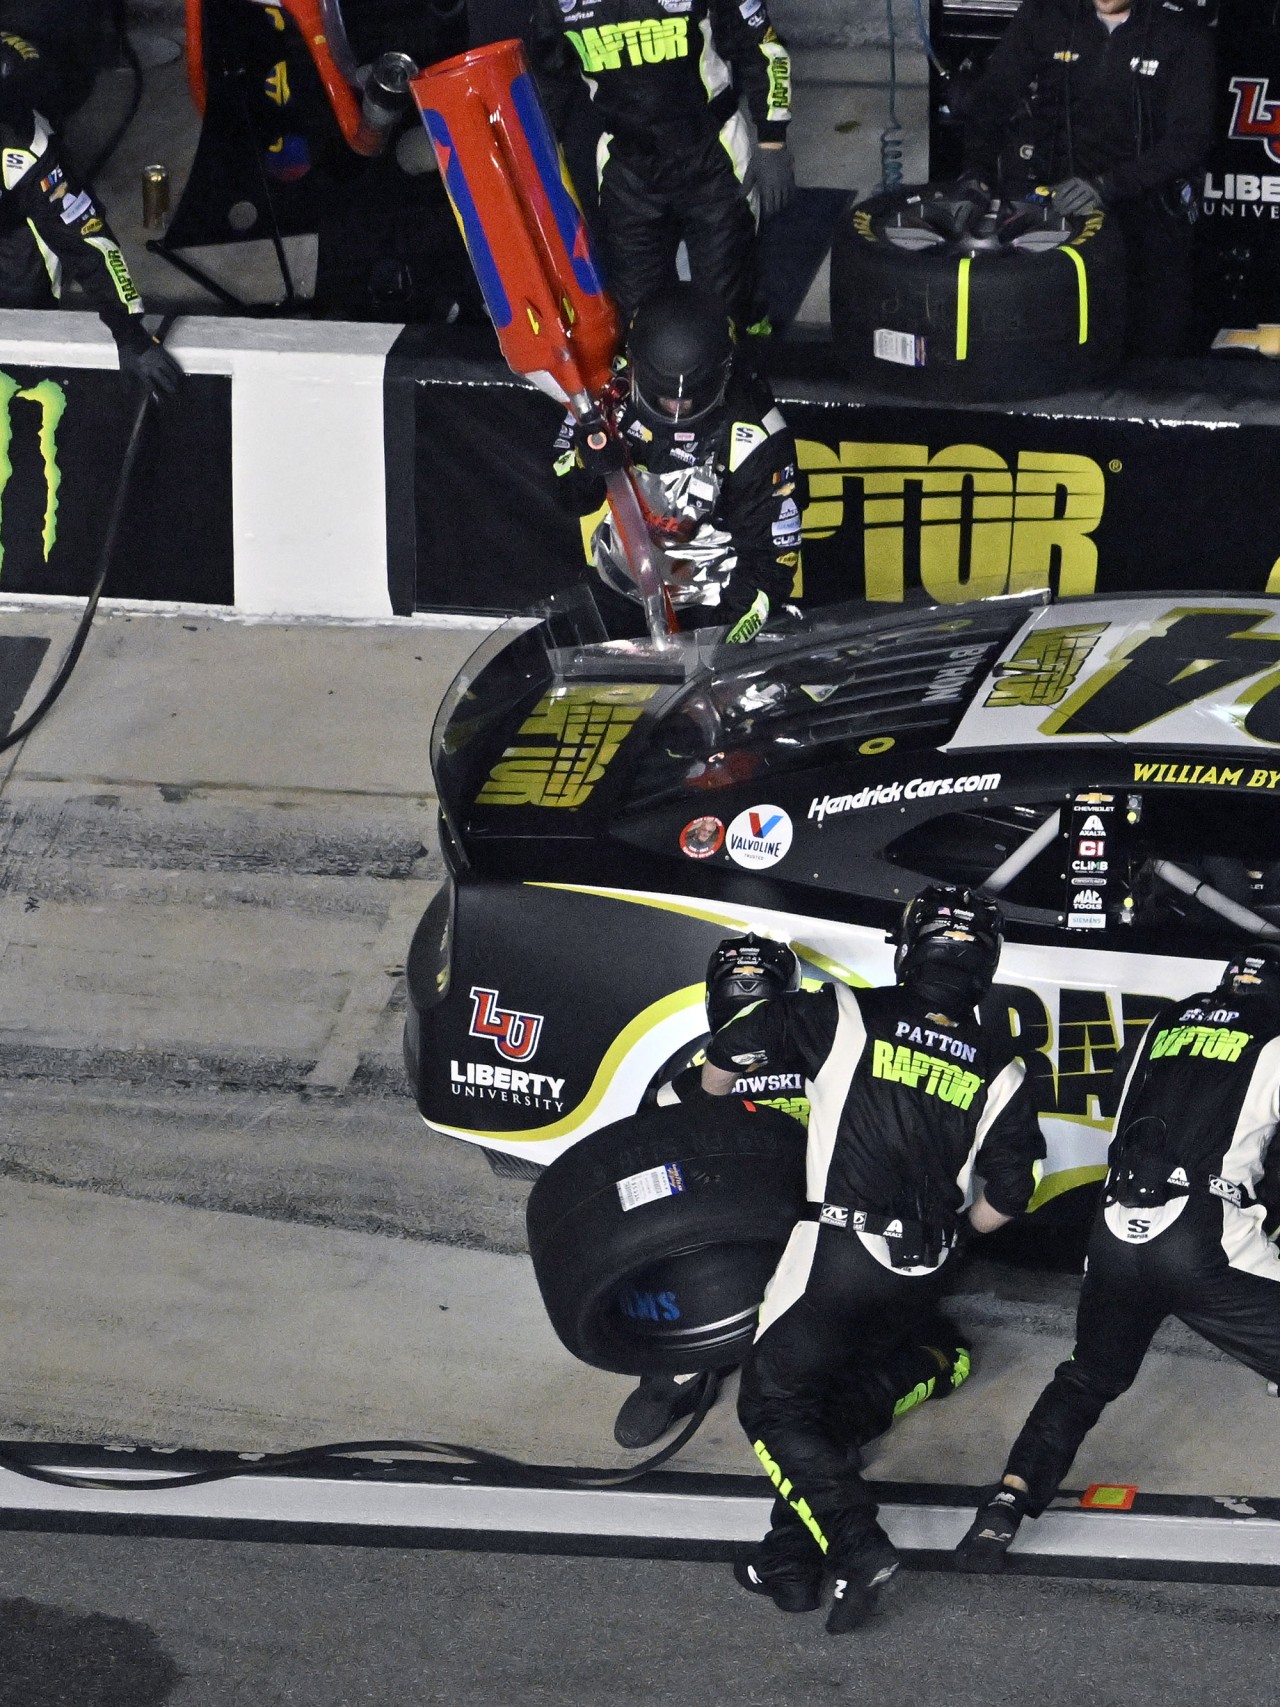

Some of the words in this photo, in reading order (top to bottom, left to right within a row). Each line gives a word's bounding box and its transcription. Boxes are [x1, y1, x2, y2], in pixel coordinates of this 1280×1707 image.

[1134, 763, 1244, 786] WILLIAM
[730, 833, 782, 858] VALVOLINE
[1073, 889, 1103, 904] MAC
[895, 1021, 977, 1063] PATTON
[450, 1060, 565, 1100] LIBERTY
[731, 1073, 801, 1096] OWSKI
[872, 1039, 983, 1111] RAPTOR
[451, 1083, 564, 1113] UNIVERSITY
